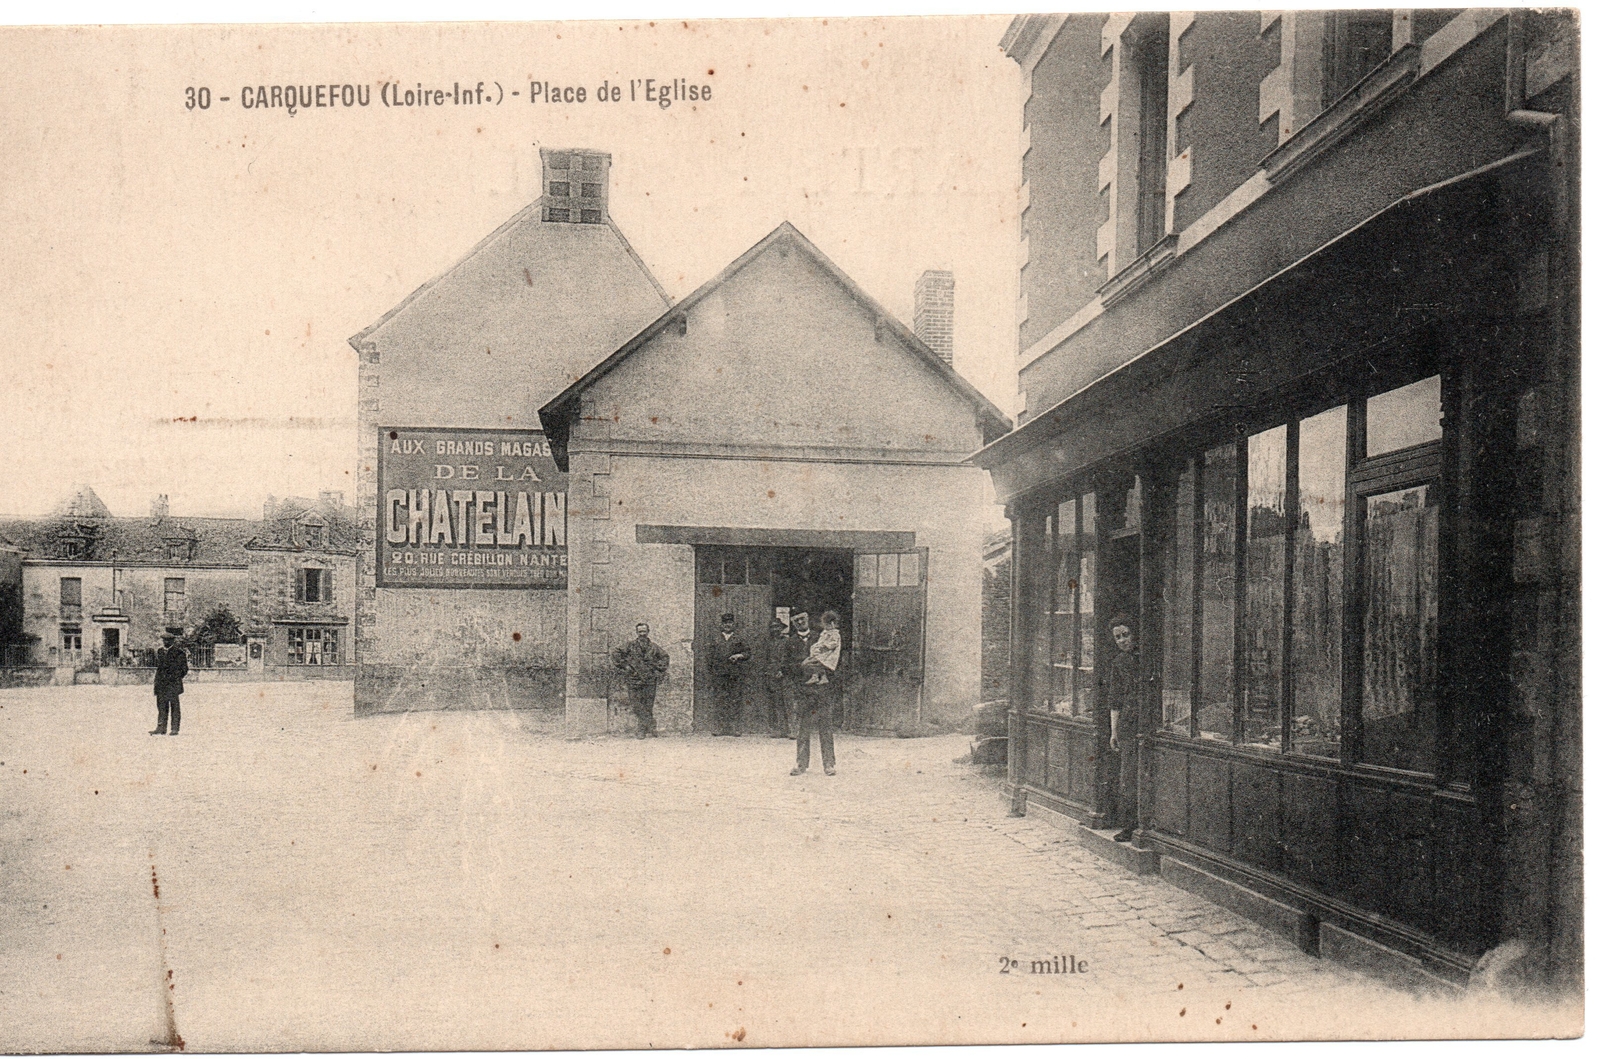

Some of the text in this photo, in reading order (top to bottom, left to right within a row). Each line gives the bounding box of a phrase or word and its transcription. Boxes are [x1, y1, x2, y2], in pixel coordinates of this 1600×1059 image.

[391, 439, 426, 455] AUX
[436, 440, 494, 456] GRANDS
[434, 464, 542, 482] DE LA
[386, 488, 567, 548] CHATELAIN
[420, 552, 445, 565] RUE
